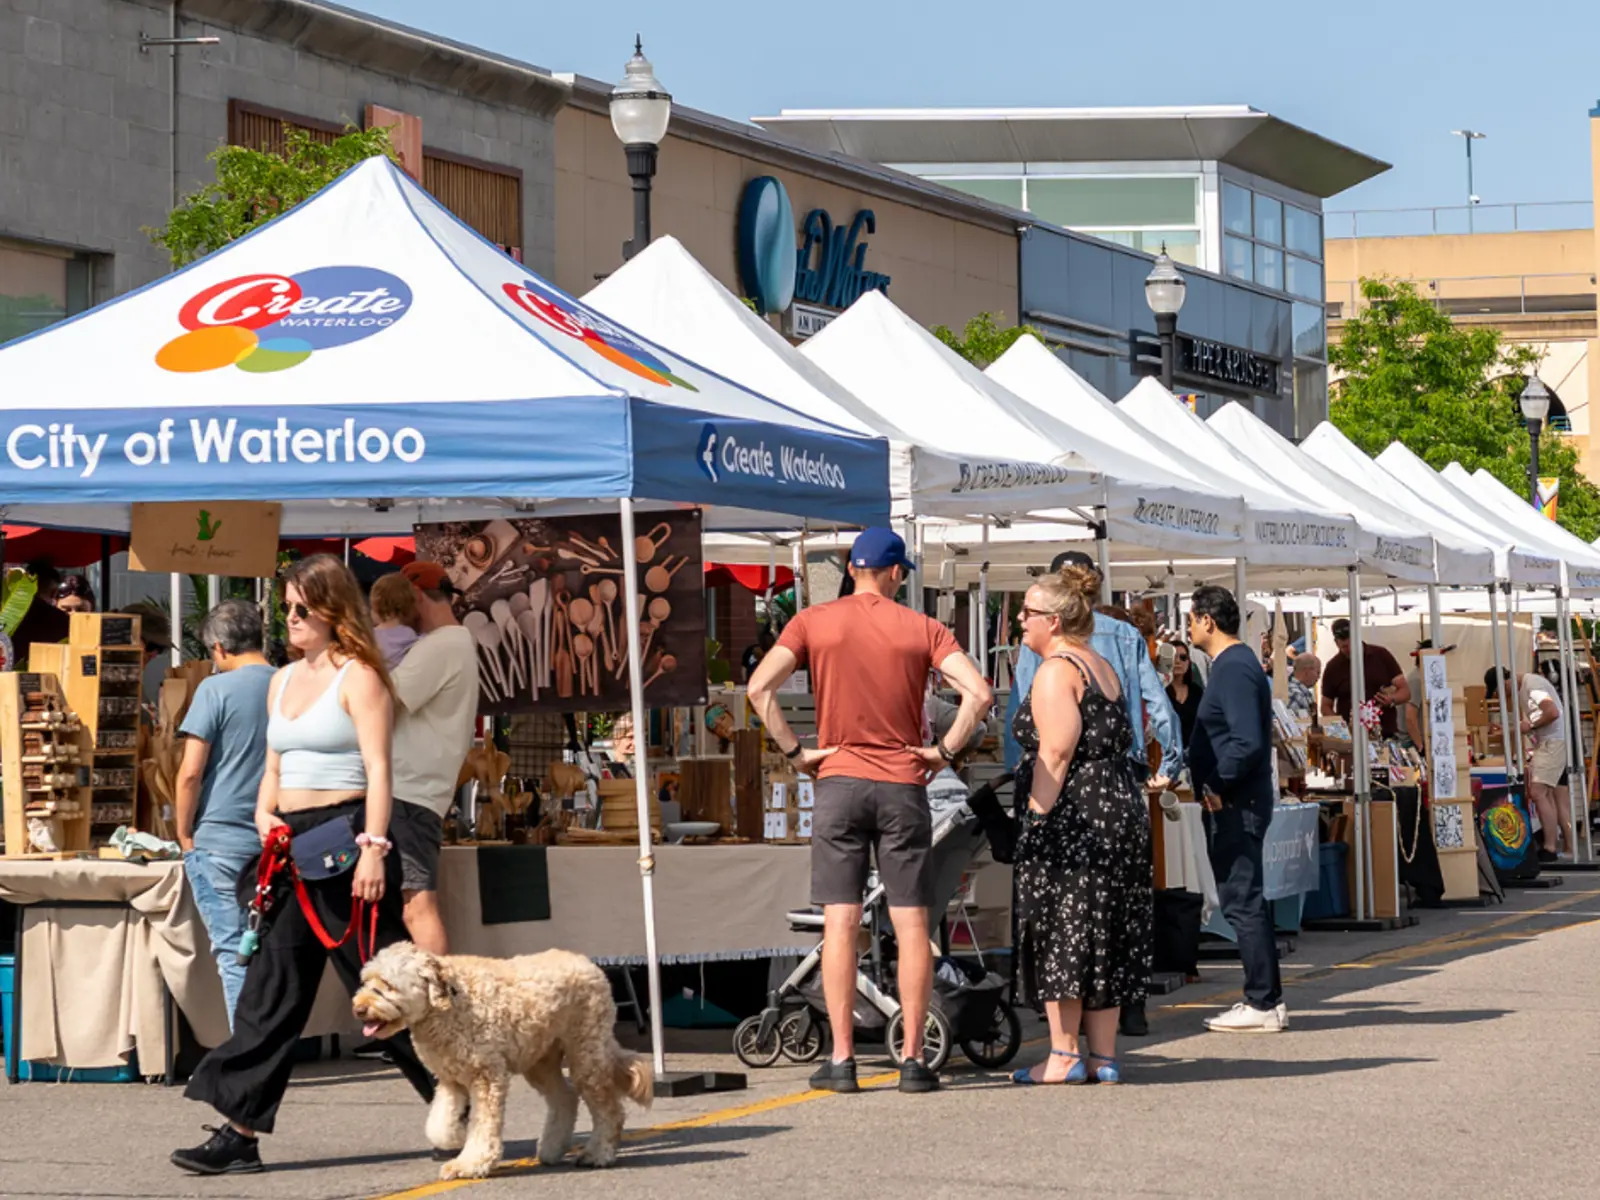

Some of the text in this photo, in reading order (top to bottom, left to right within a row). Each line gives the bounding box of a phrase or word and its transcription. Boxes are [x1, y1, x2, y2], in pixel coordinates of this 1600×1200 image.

[197, 277, 405, 326] Create
[279, 316, 395, 328] WATERLOO
[6, 417, 426, 478] City of Waterloo
[722, 435, 846, 490] Create_Waterloo
